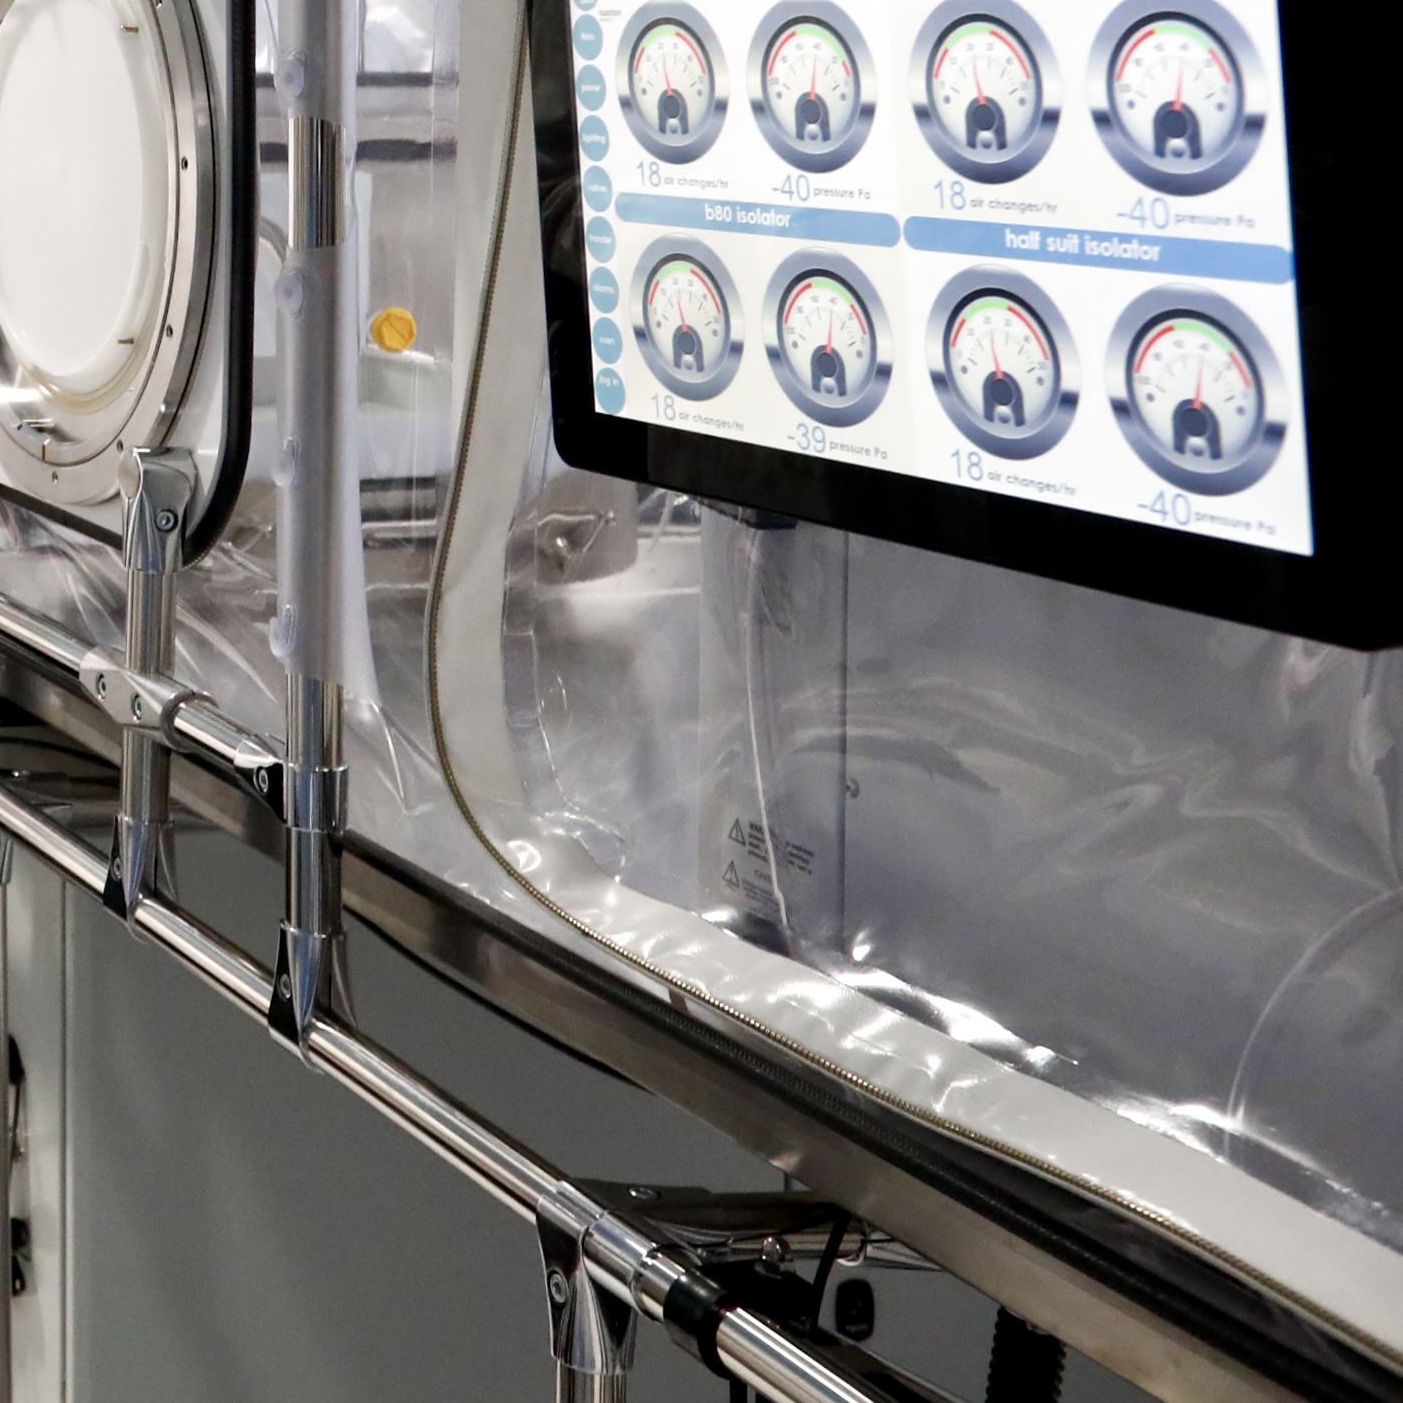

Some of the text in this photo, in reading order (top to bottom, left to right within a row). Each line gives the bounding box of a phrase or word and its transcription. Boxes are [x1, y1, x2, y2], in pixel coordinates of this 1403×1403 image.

[636, 161, 661, 187] 18
[771, 173, 811, 202] -40
[934, 180, 966, 210] 18
[705, 204, 791, 227] b80 isolator
[1115, 196, 1171, 230] -40
[1005, 228, 1161, 261] half suit isolator
[599, 376, 619, 388] log in
[651, 393, 677, 421] 18
[692, 413, 745, 431] changes/hr
[787, 422, 887, 460] -39 pressure Pa
[951, 448, 984, 482] 18
[1137, 490, 1192, 526] -40
